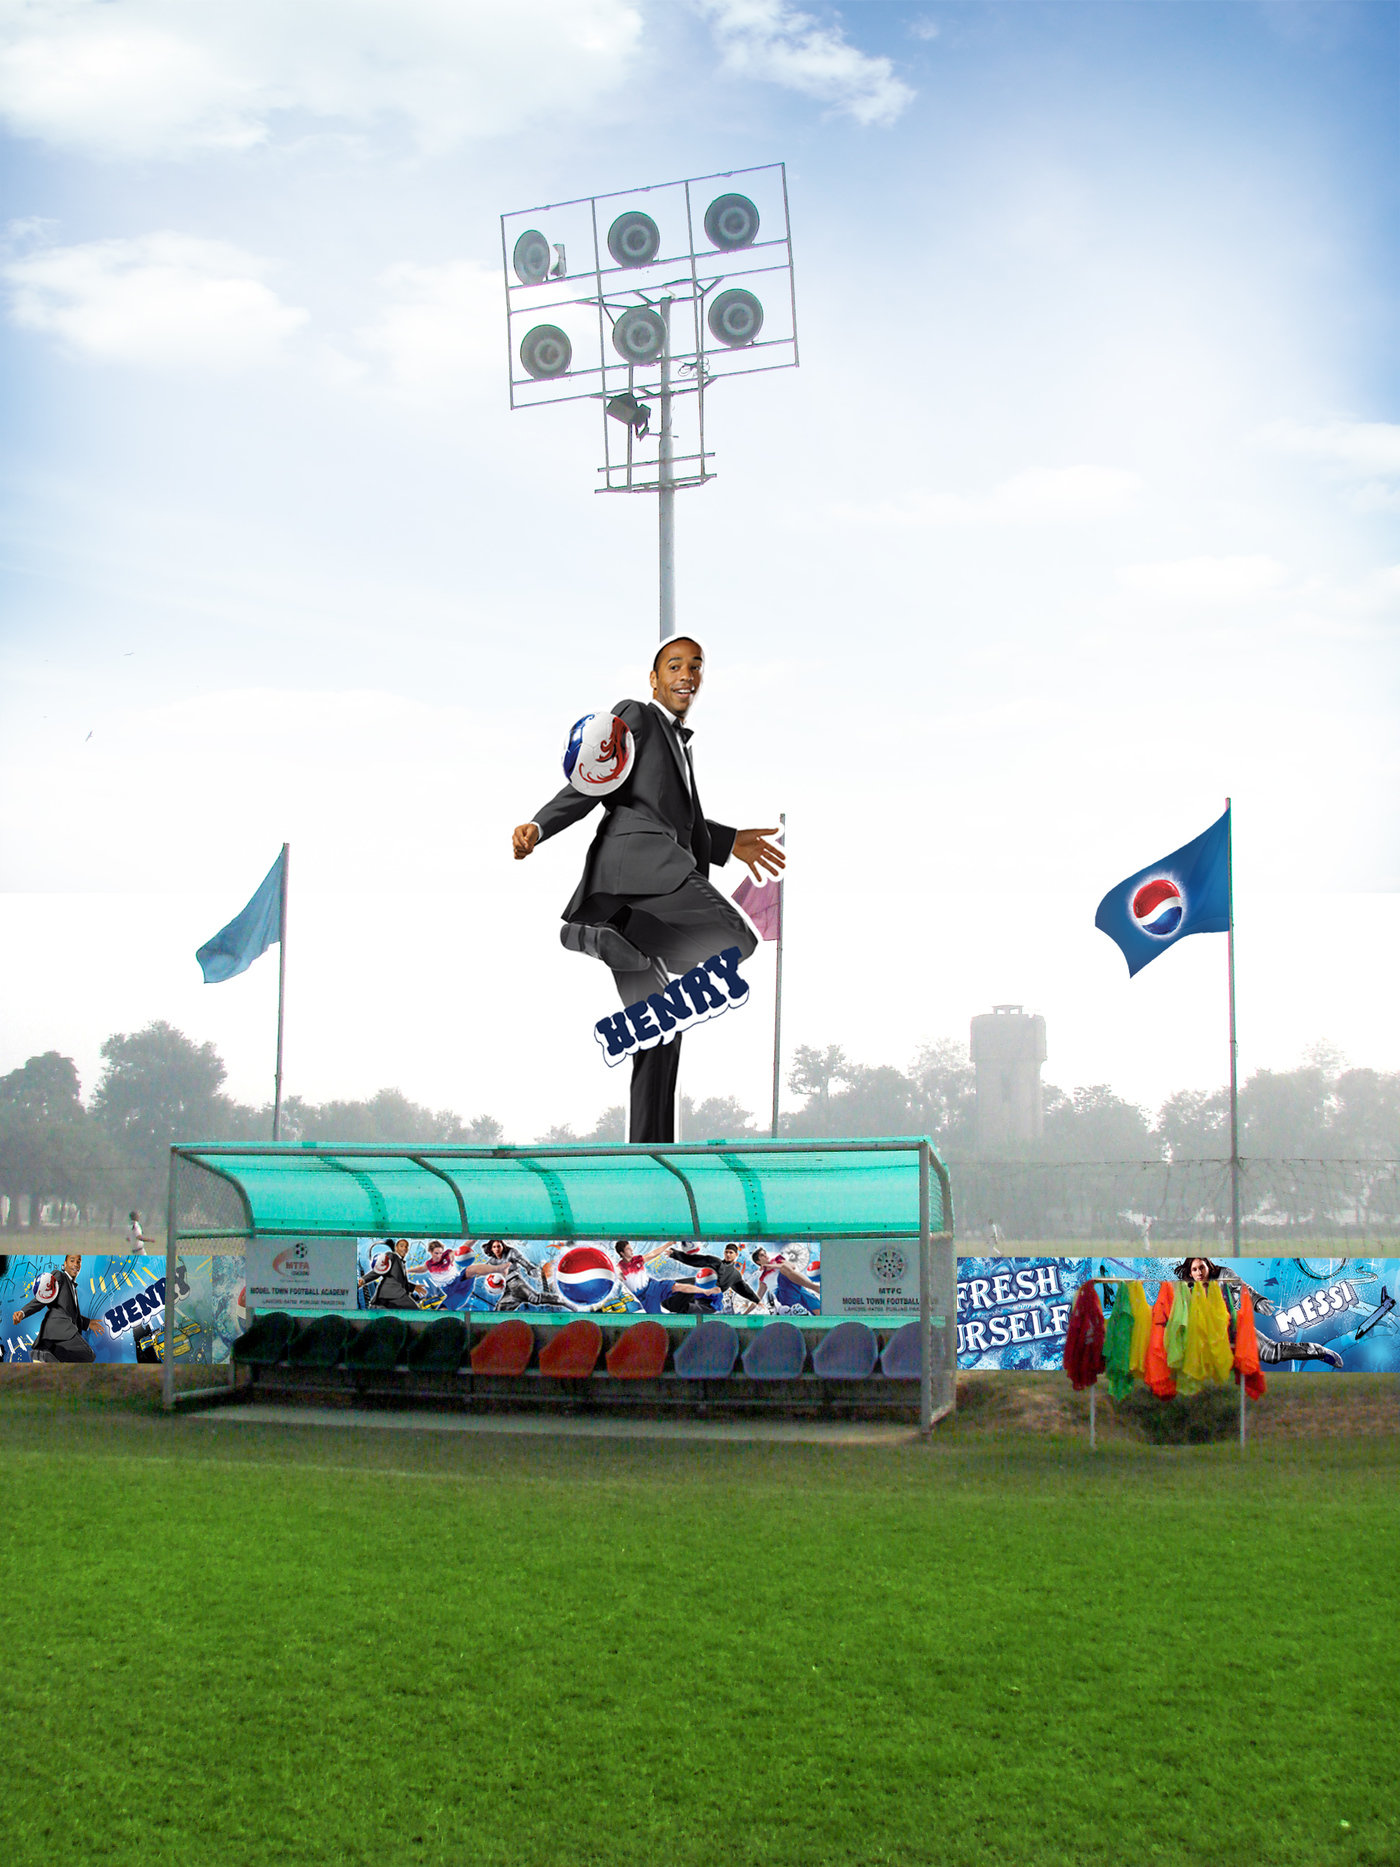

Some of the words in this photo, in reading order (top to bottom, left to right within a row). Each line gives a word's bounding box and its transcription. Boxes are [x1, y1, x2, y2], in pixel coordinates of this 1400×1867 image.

[595, 945, 750, 1060] HENRY
[272, 1287, 289, 1295] TOWN
[290, 1288, 319, 1296] FOOTBALL
[842, 1297, 865, 1305] MODEL
[866, 1297, 885, 1305] TOWN
[886, 1297, 920, 1305] FOOTBALL
[878, 1287, 902, 1295] MTFC
[957, 1265, 1062, 1313] FRESH
[1275, 1279, 1358, 1336] MESSI
